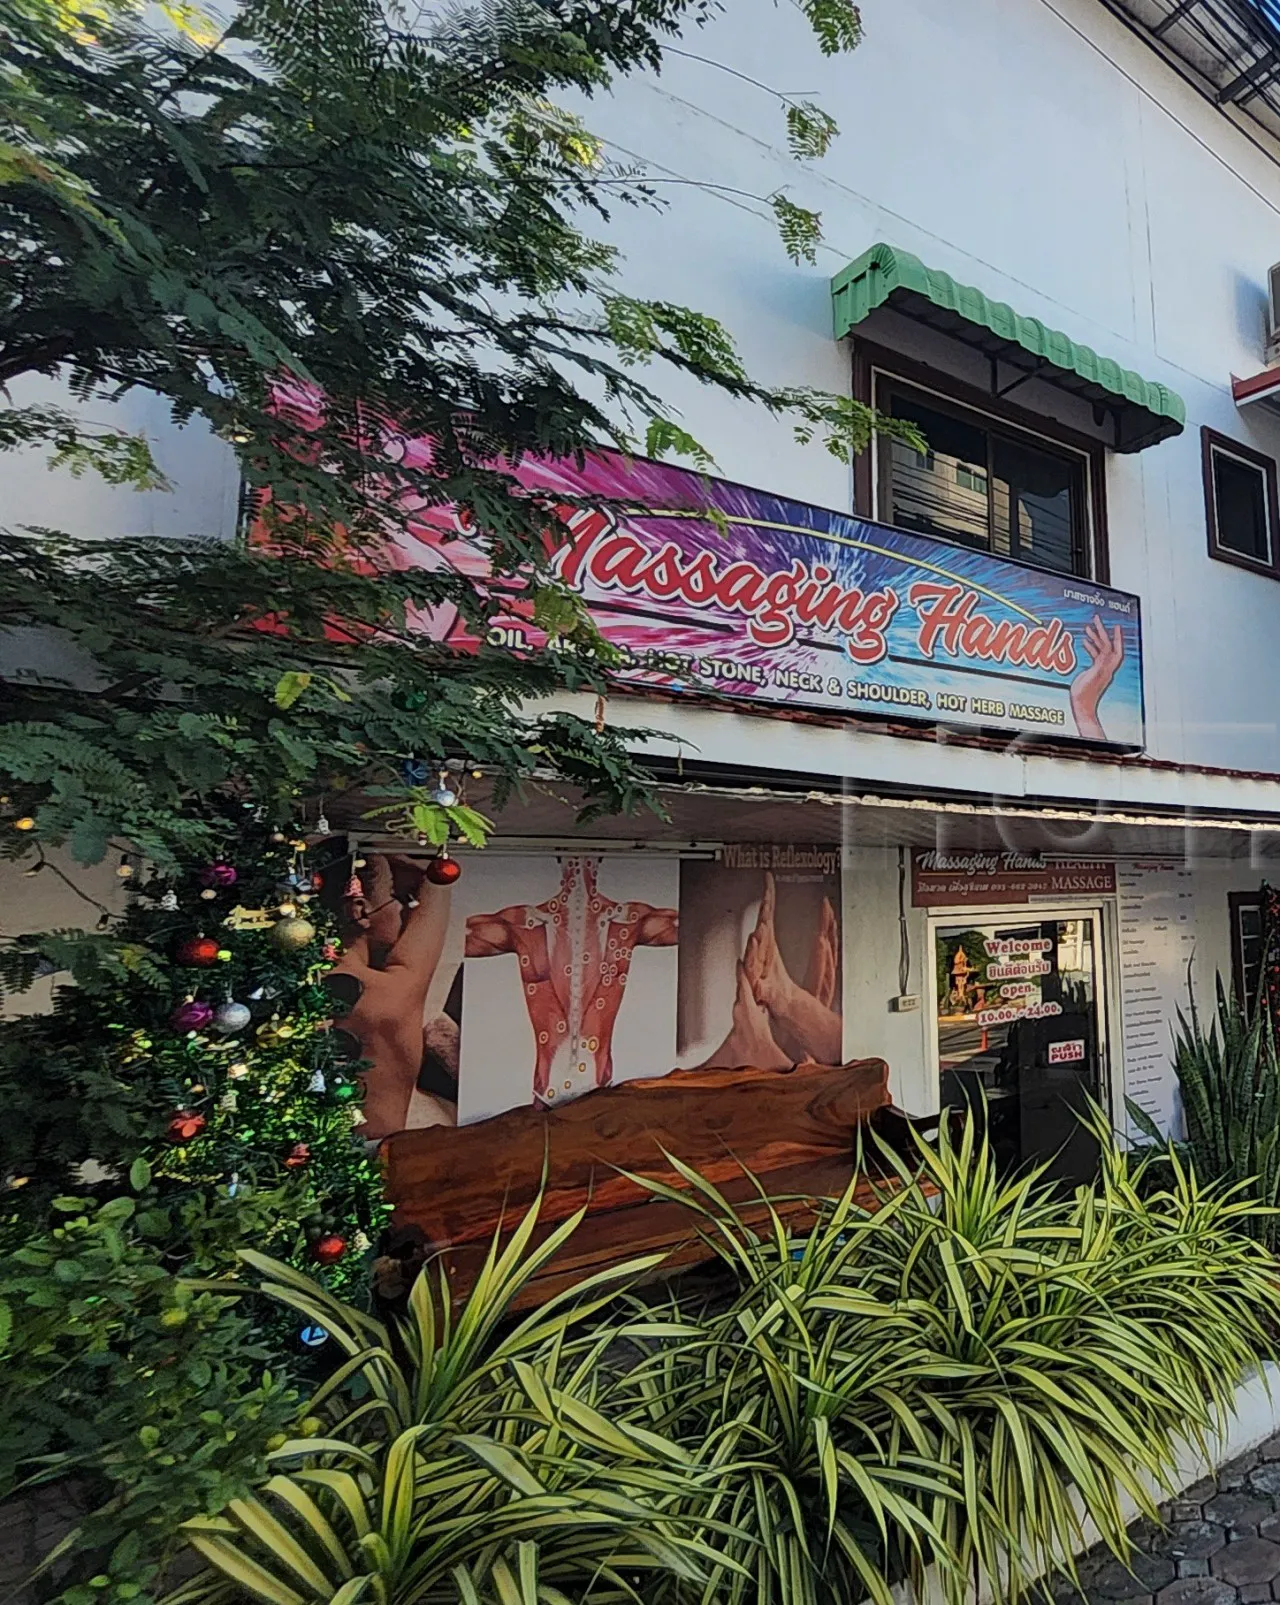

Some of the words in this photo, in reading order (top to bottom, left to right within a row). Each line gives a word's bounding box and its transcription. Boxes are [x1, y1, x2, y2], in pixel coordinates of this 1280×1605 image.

[908, 581, 1078, 676] Hands
[698, 655, 768, 687] STONE,
[773, 670, 823, 693] NECK
[828, 679, 841, 697] &
[846, 681, 932, 710] SHOULDER,
[936, 693, 967, 712] HOT
[971, 698, 1005, 717] HERB
[1008, 704, 1066, 726] MASSAGE
[723, 843, 758, 868] What
[759, 845, 770, 868] is
[772, 844, 842, 875] Reflexology?
[915, 850, 999, 876] Massaging
[1051, 876, 1112, 890] MASSAGE
[985, 940, 1051, 955] Welcome
[1001, 985, 1036, 997] open.
[1051, 1051, 1082, 1062] PUSH
